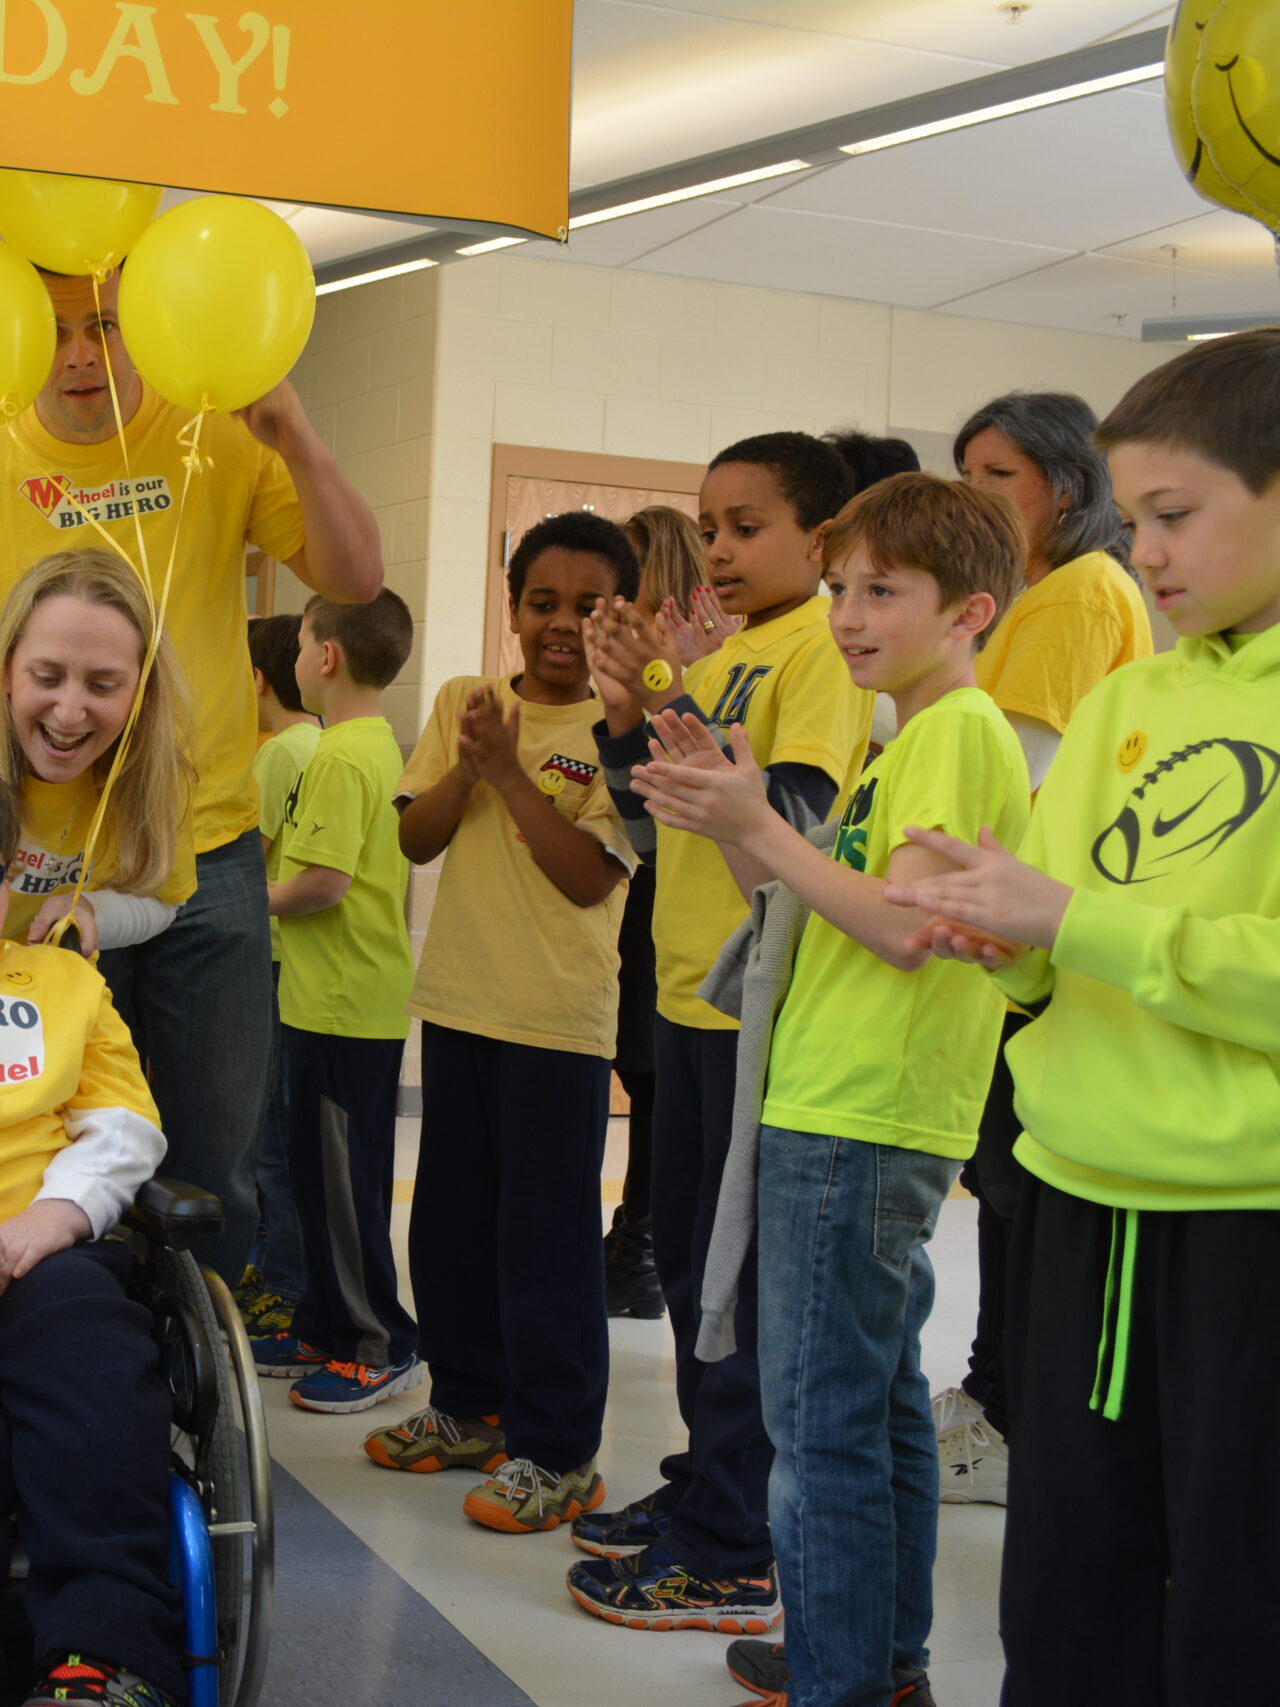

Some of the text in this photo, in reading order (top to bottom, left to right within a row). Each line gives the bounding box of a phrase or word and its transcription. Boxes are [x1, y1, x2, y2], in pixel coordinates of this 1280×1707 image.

[120, 483, 130, 496] is
[135, 479, 164, 493] our
[59, 494, 171, 528] BIG HERO
